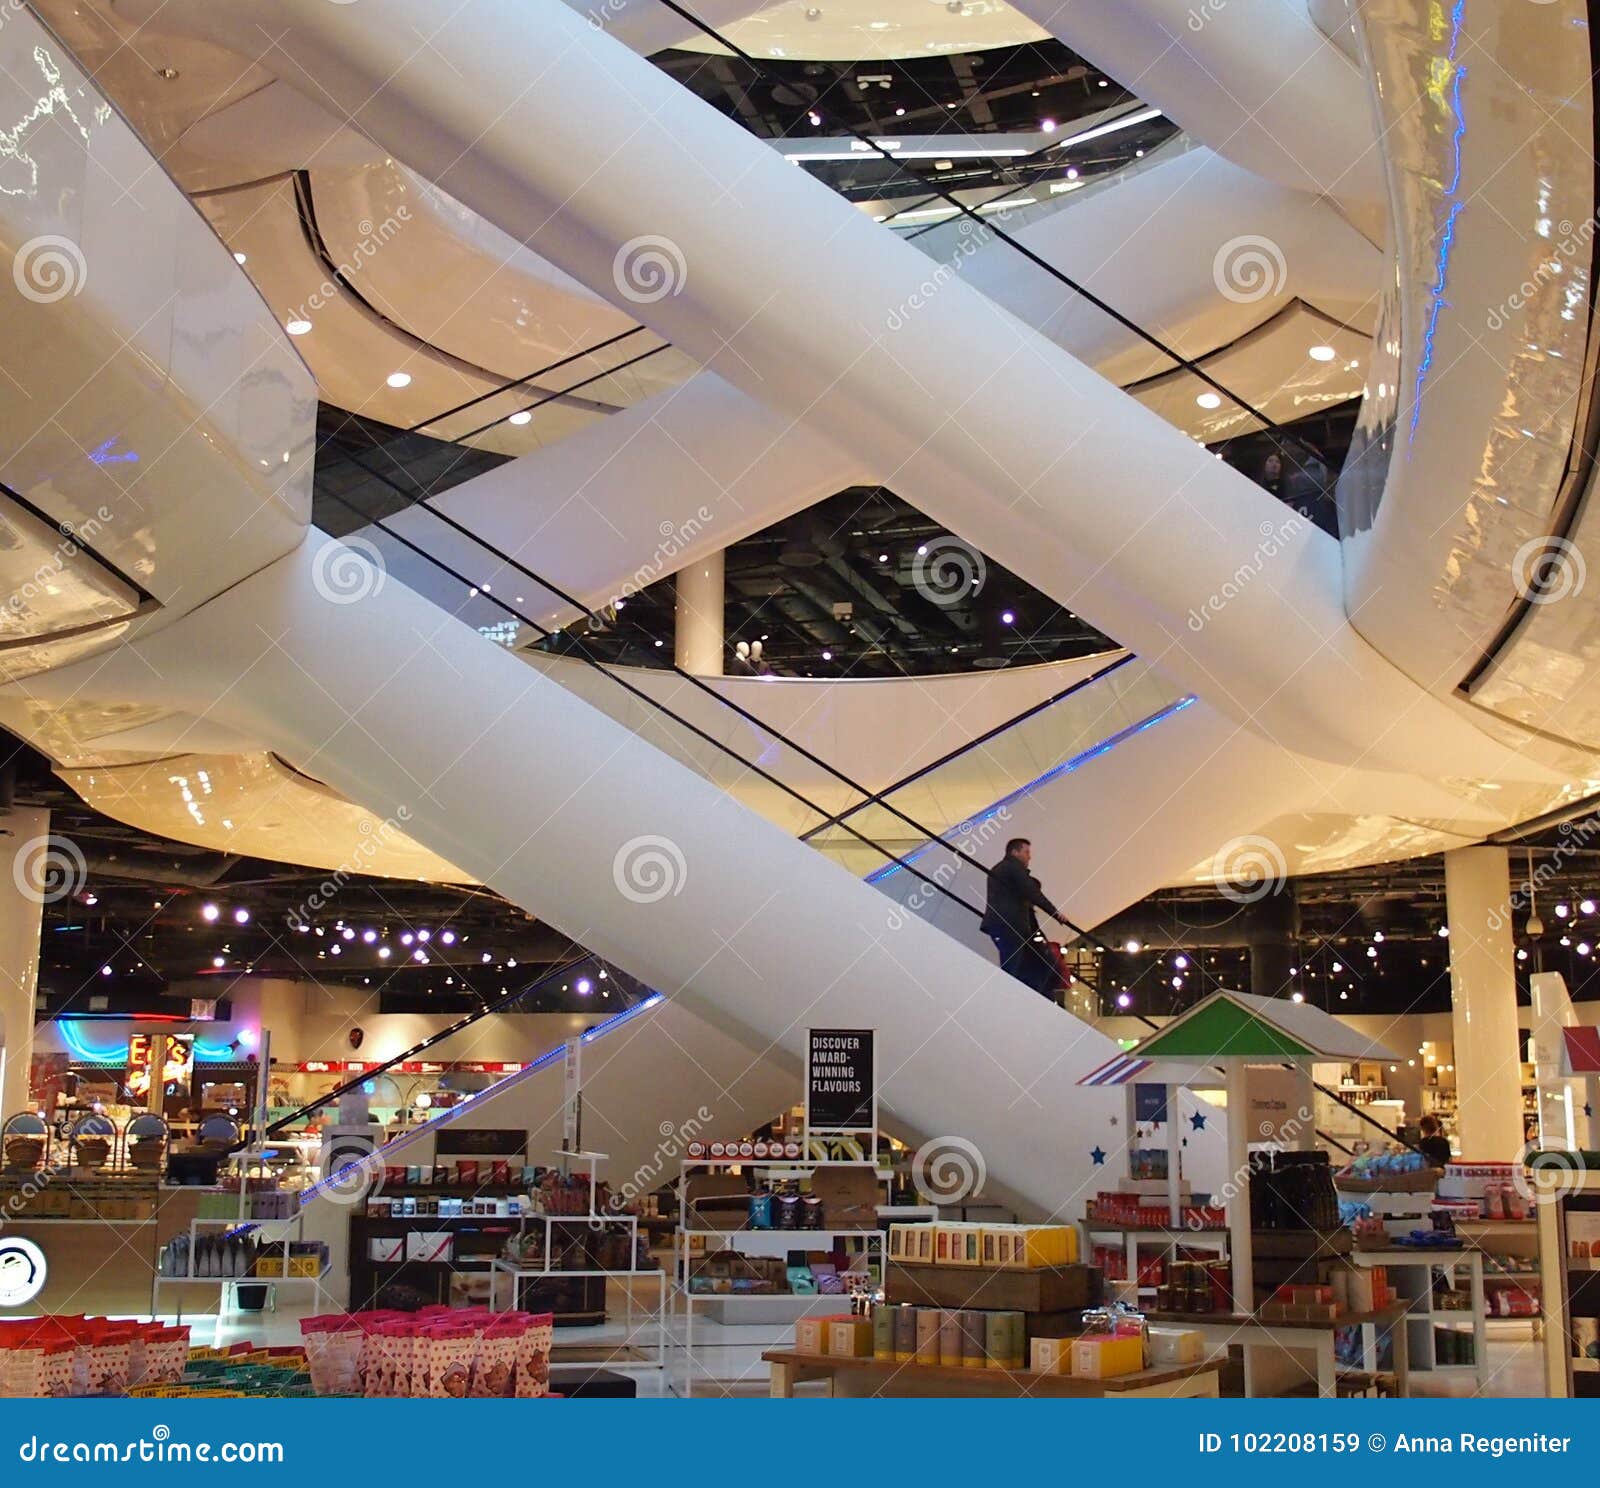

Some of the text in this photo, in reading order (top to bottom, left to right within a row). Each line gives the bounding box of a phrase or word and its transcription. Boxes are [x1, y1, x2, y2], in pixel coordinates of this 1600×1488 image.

[812, 1037, 860, 1049] DISCOVER
[131, 1037, 186, 1065] E's
[812, 1051, 852, 1064] AWARD-
[812, 1066, 855, 1078] WINNING
[812, 1080, 861, 1093] FLAVOURS
